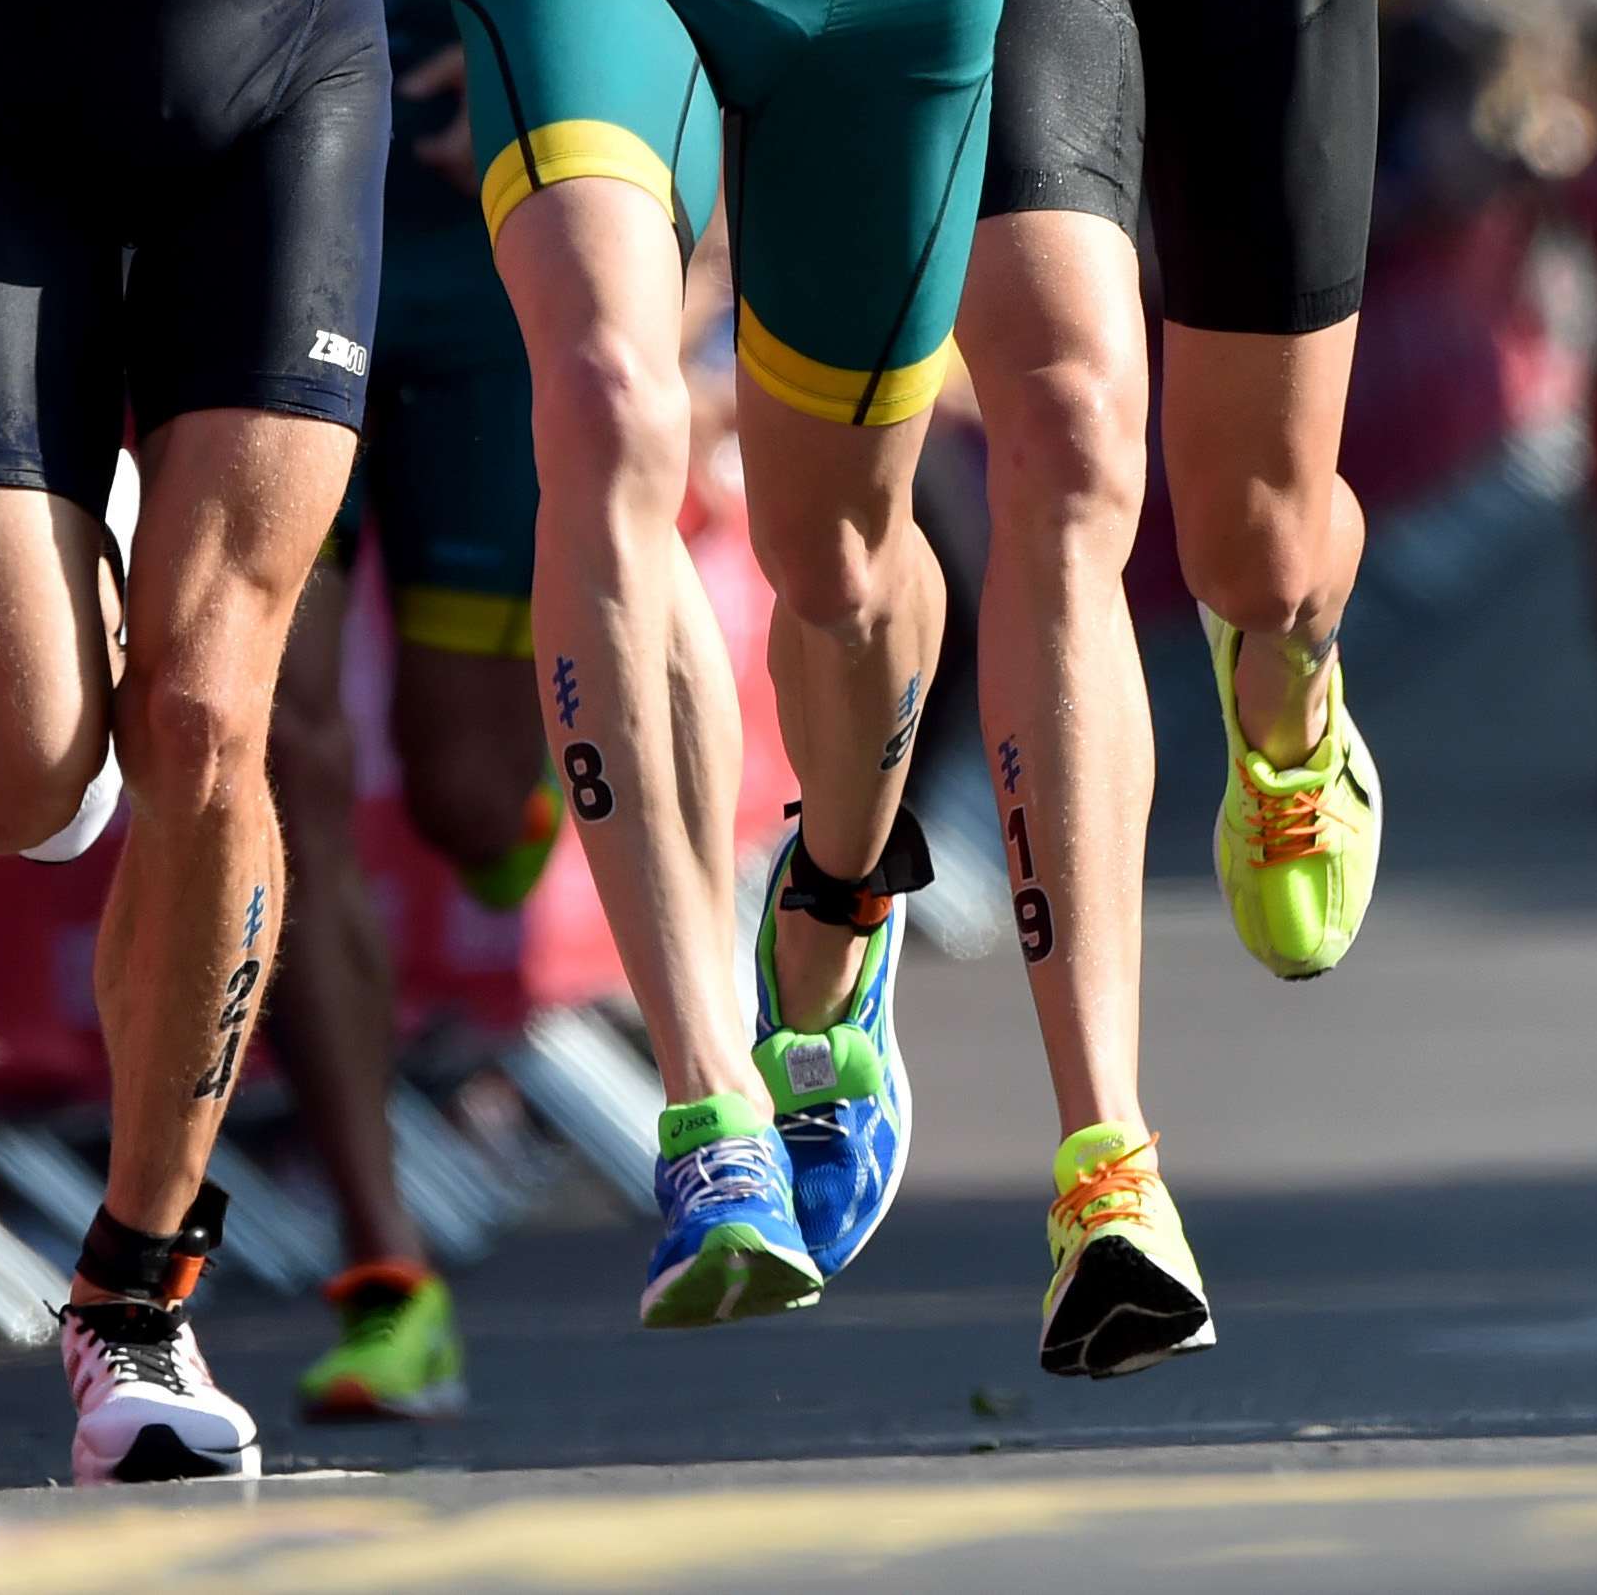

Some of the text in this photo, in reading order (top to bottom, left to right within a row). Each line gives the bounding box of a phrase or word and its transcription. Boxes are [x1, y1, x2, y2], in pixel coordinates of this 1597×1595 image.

[562, 740, 616, 824] 8
[880, 709, 920, 771] 8
[1007, 805, 1054, 966] 19
[192, 958, 261, 1100] 24
